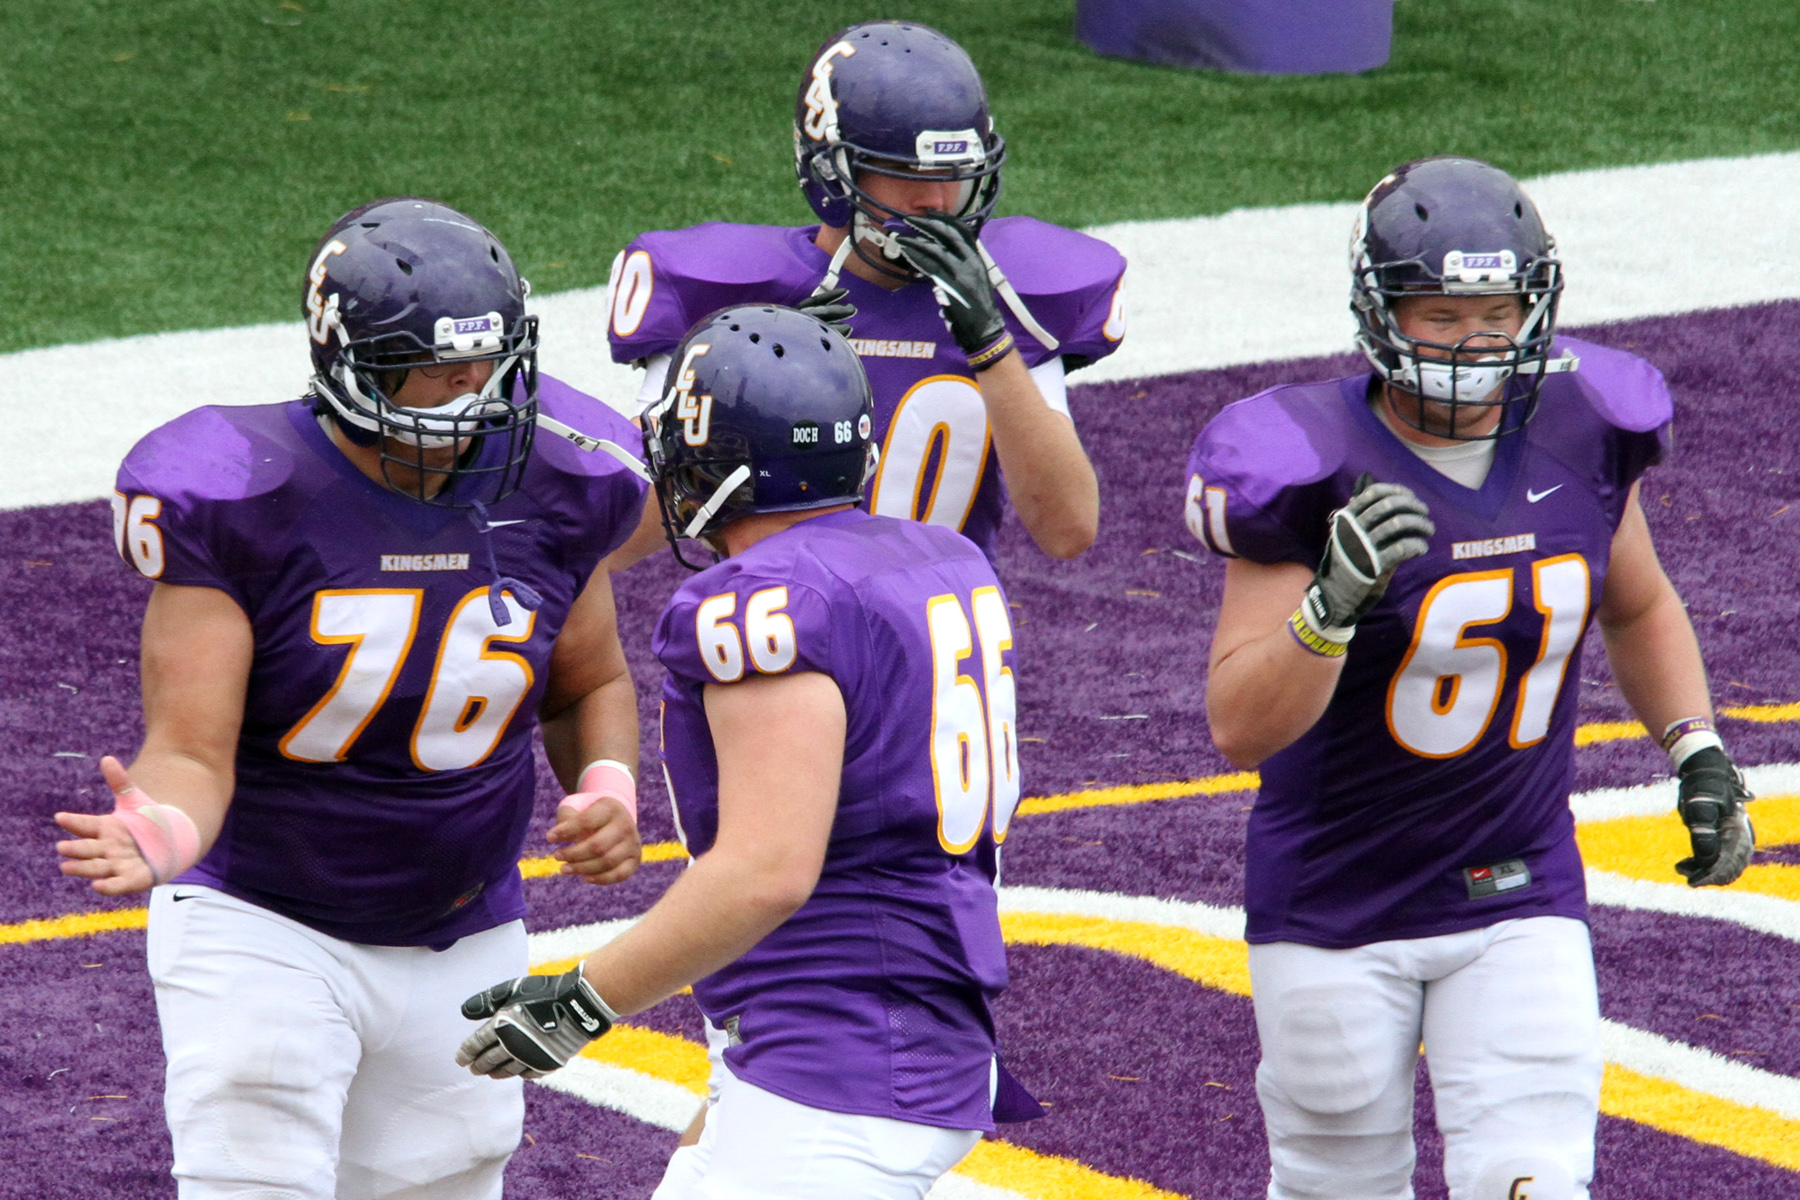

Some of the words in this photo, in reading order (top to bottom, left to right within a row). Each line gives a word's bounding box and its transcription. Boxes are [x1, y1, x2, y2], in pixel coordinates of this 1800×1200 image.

[834, 420, 852, 444] 66
[380, 553, 469, 571] KINGSMEN
[1452, 532, 1536, 560] KINGSMEN
[278, 585, 537, 773] 76
[696, 586, 797, 682] 66
[1385, 552, 1591, 760] 61
[926, 585, 1020, 855] 66
